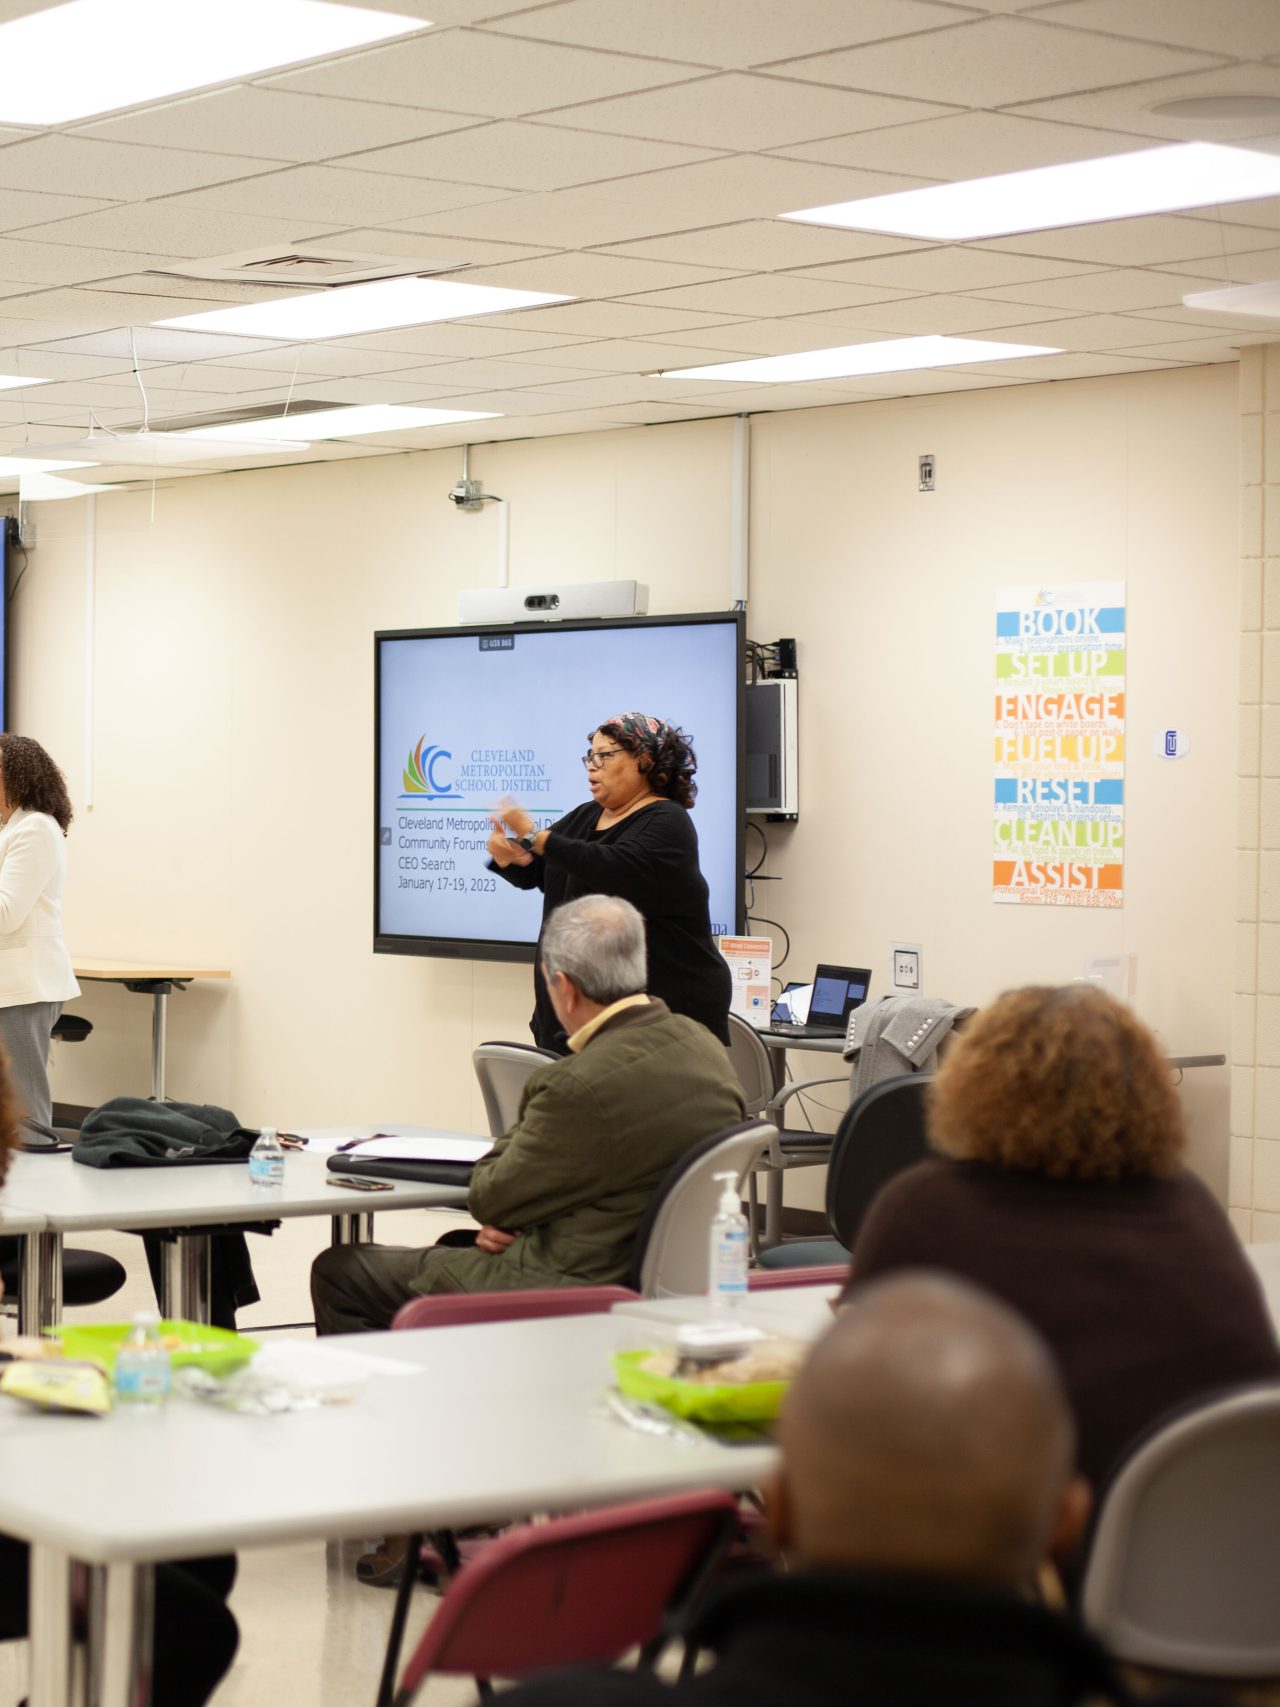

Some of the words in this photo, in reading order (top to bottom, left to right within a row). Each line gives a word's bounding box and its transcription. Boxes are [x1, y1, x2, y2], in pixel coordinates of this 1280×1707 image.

[1019, 607, 1102, 636] BOOK
[1010, 652, 1057, 679] SET
[1068, 651, 1108, 678] UP
[1001, 693, 1118, 720] ENGAGE
[471, 750, 535, 762] CLEVELAND
[1001, 736, 1068, 762] FUEL
[1077, 736, 1117, 762] UP
[461, 764, 545, 777] METROPOLITAN
[455, 779, 498, 792] SCHOOL
[501, 779, 552, 792] DISTRICT
[1017, 778, 1101, 805] RESET
[398, 817, 444, 830] Cleveland
[446, 817, 507, 833] Metropolitn
[995, 819, 1076, 847] CLEAN
[1087, 820, 1123, 848] UP
[398, 836, 450, 852] Community
[398, 856, 418, 870] CEO
[422, 857, 455, 871] Search
[1010, 860, 1104, 888] ASSIST
[398, 876, 434, 892] January
[437, 877, 467, 893] 17-19,
[471, 878, 496, 892] 2023
